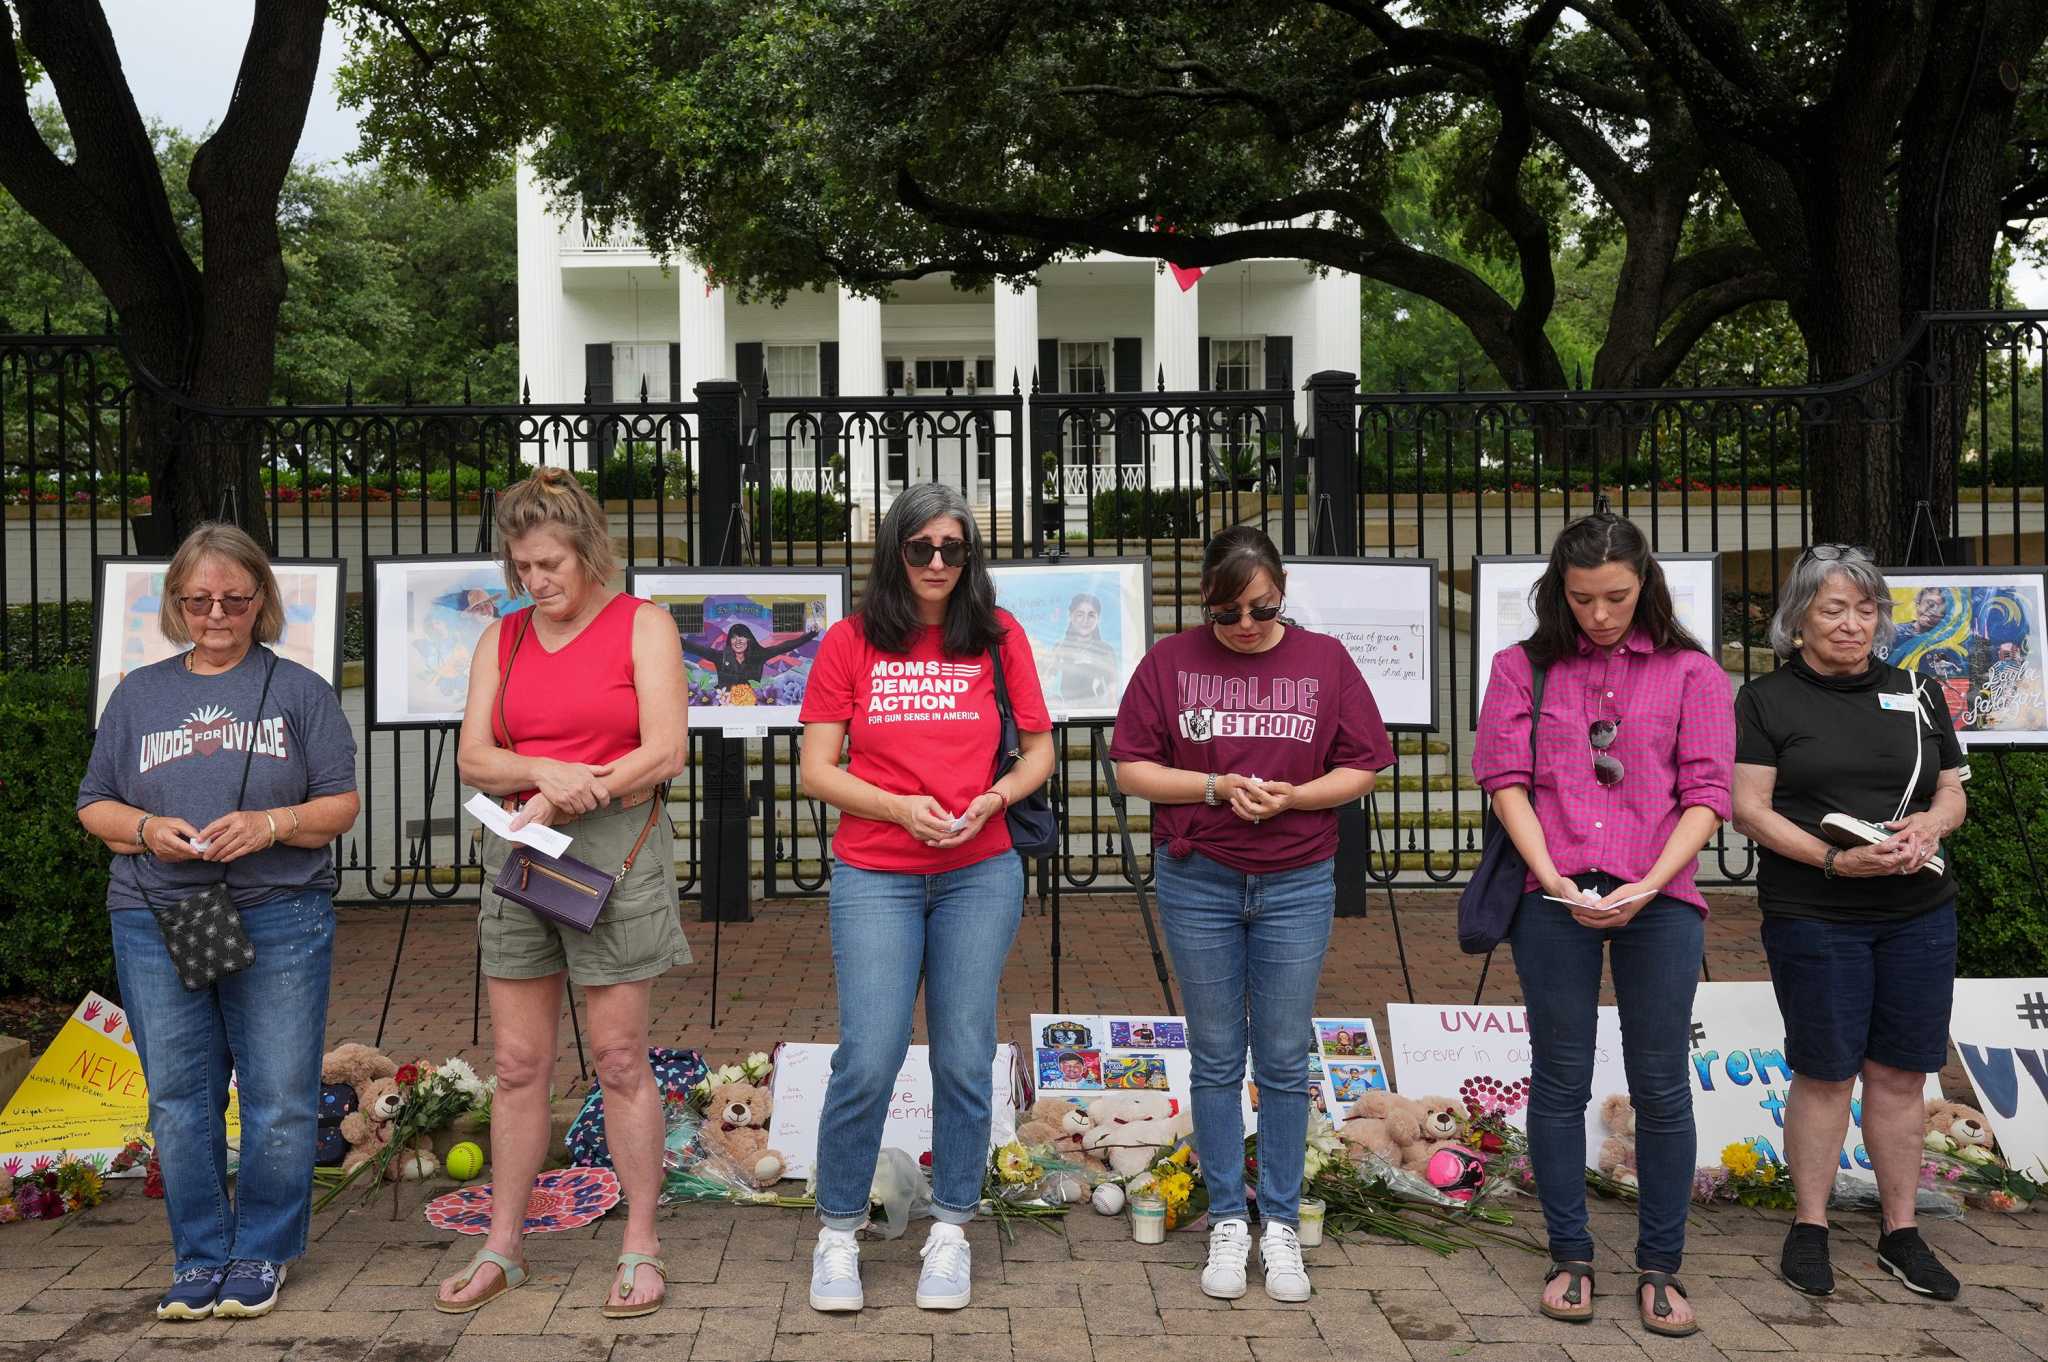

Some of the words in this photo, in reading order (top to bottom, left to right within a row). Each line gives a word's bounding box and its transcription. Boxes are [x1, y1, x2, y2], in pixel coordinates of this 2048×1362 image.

[871, 660, 940, 678] MOMS
[870, 677, 969, 694] DEMAND
[1178, 670, 1319, 717] UVALDE
[868, 694, 956, 713] ACTION
[868, 715, 882, 725] FOR
[884, 713, 901, 723] GUN
[904, 712, 930, 721] SENSE
[932, 712, 941, 721] IN
[943, 711, 980, 721] AMERICA
[1221, 713, 1315, 742] STRONG
[139, 727, 193, 774] UNIDOS
[194, 728, 221, 743] FOR
[222, 716, 287, 759] UVALDE
[1440, 1011, 1529, 1033] UVAL
[1402, 1043, 1464, 1064] forever
[1472, 1045, 1491, 1063] in
[1507, 1048, 1532, 1064] ou
[69, 1049, 149, 1099] NEVE
[1691, 1047, 1794, 1092] rem
